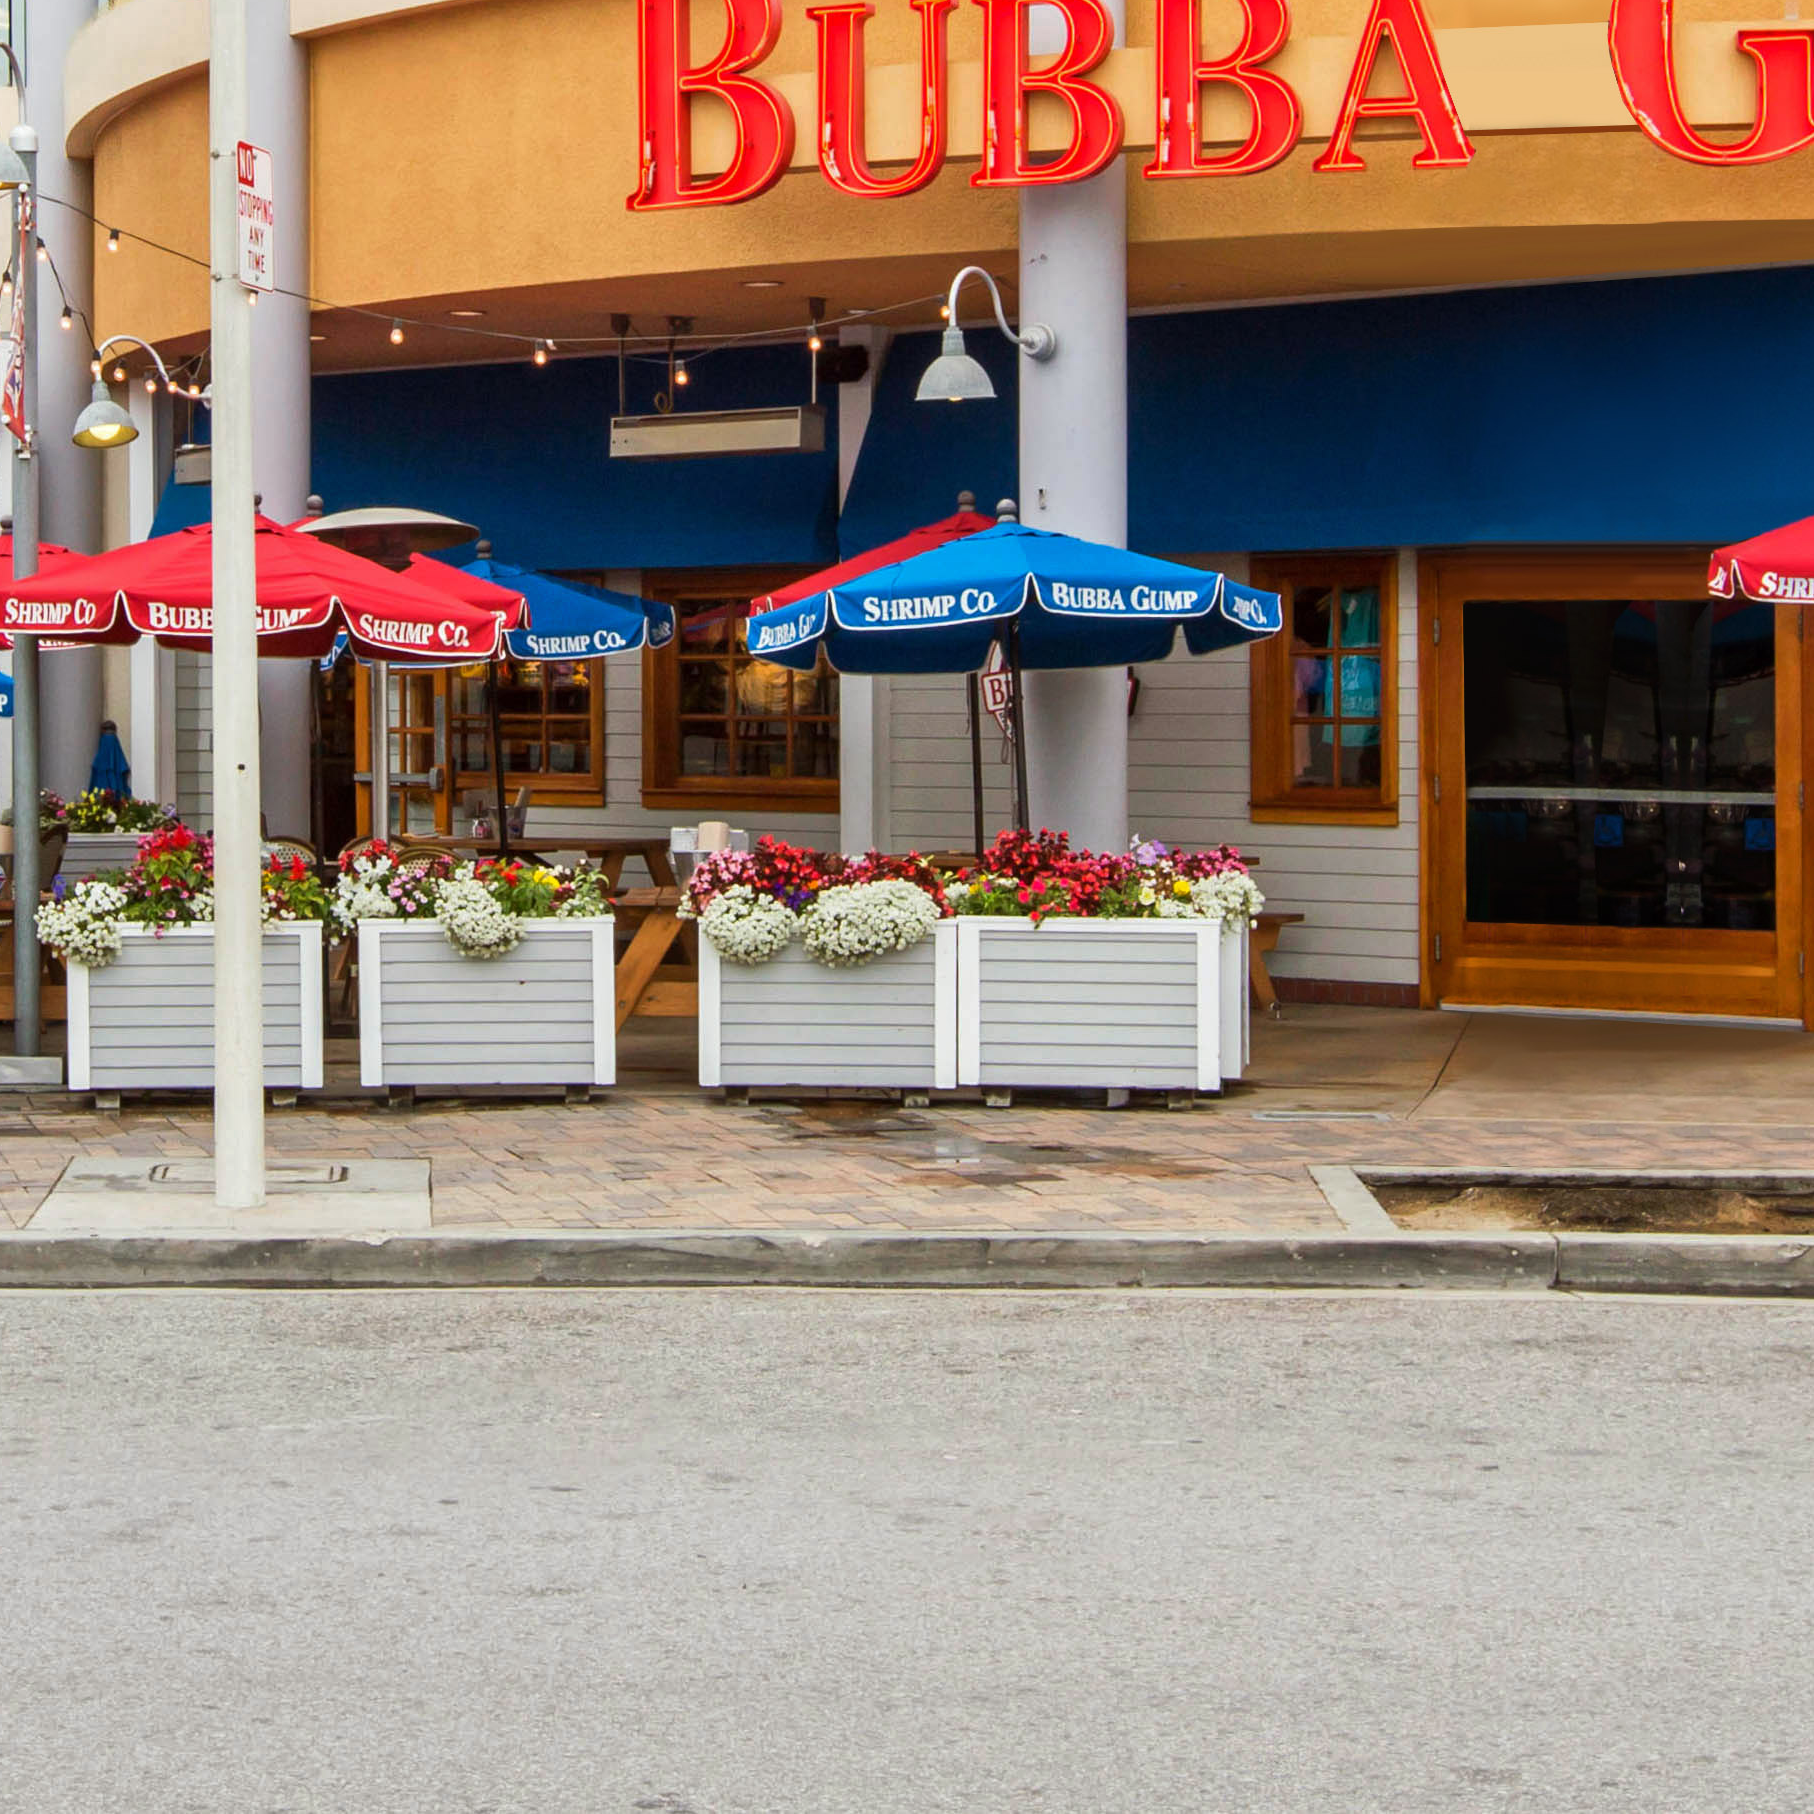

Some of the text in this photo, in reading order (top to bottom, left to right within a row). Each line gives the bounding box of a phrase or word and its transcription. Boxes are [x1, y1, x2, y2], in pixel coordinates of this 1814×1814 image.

[239, 147, 253, 182] NO
[239, 190, 274, 226] STOPPING
[249, 226, 265, 247] ANY
[248, 250, 266, 274] TIME
[4, 597, 71, 625] SHRIMP
[863, 595, 956, 623] SHRIMP
[1051, 582, 1198, 612] BUBBA GUMP
[147, 601, 214, 630] BUBB
[358, 613, 435, 646] SHRIMP
[526, 630, 626, 654] SHRIMP CO.
[756, 621, 797, 649] BUBBA
